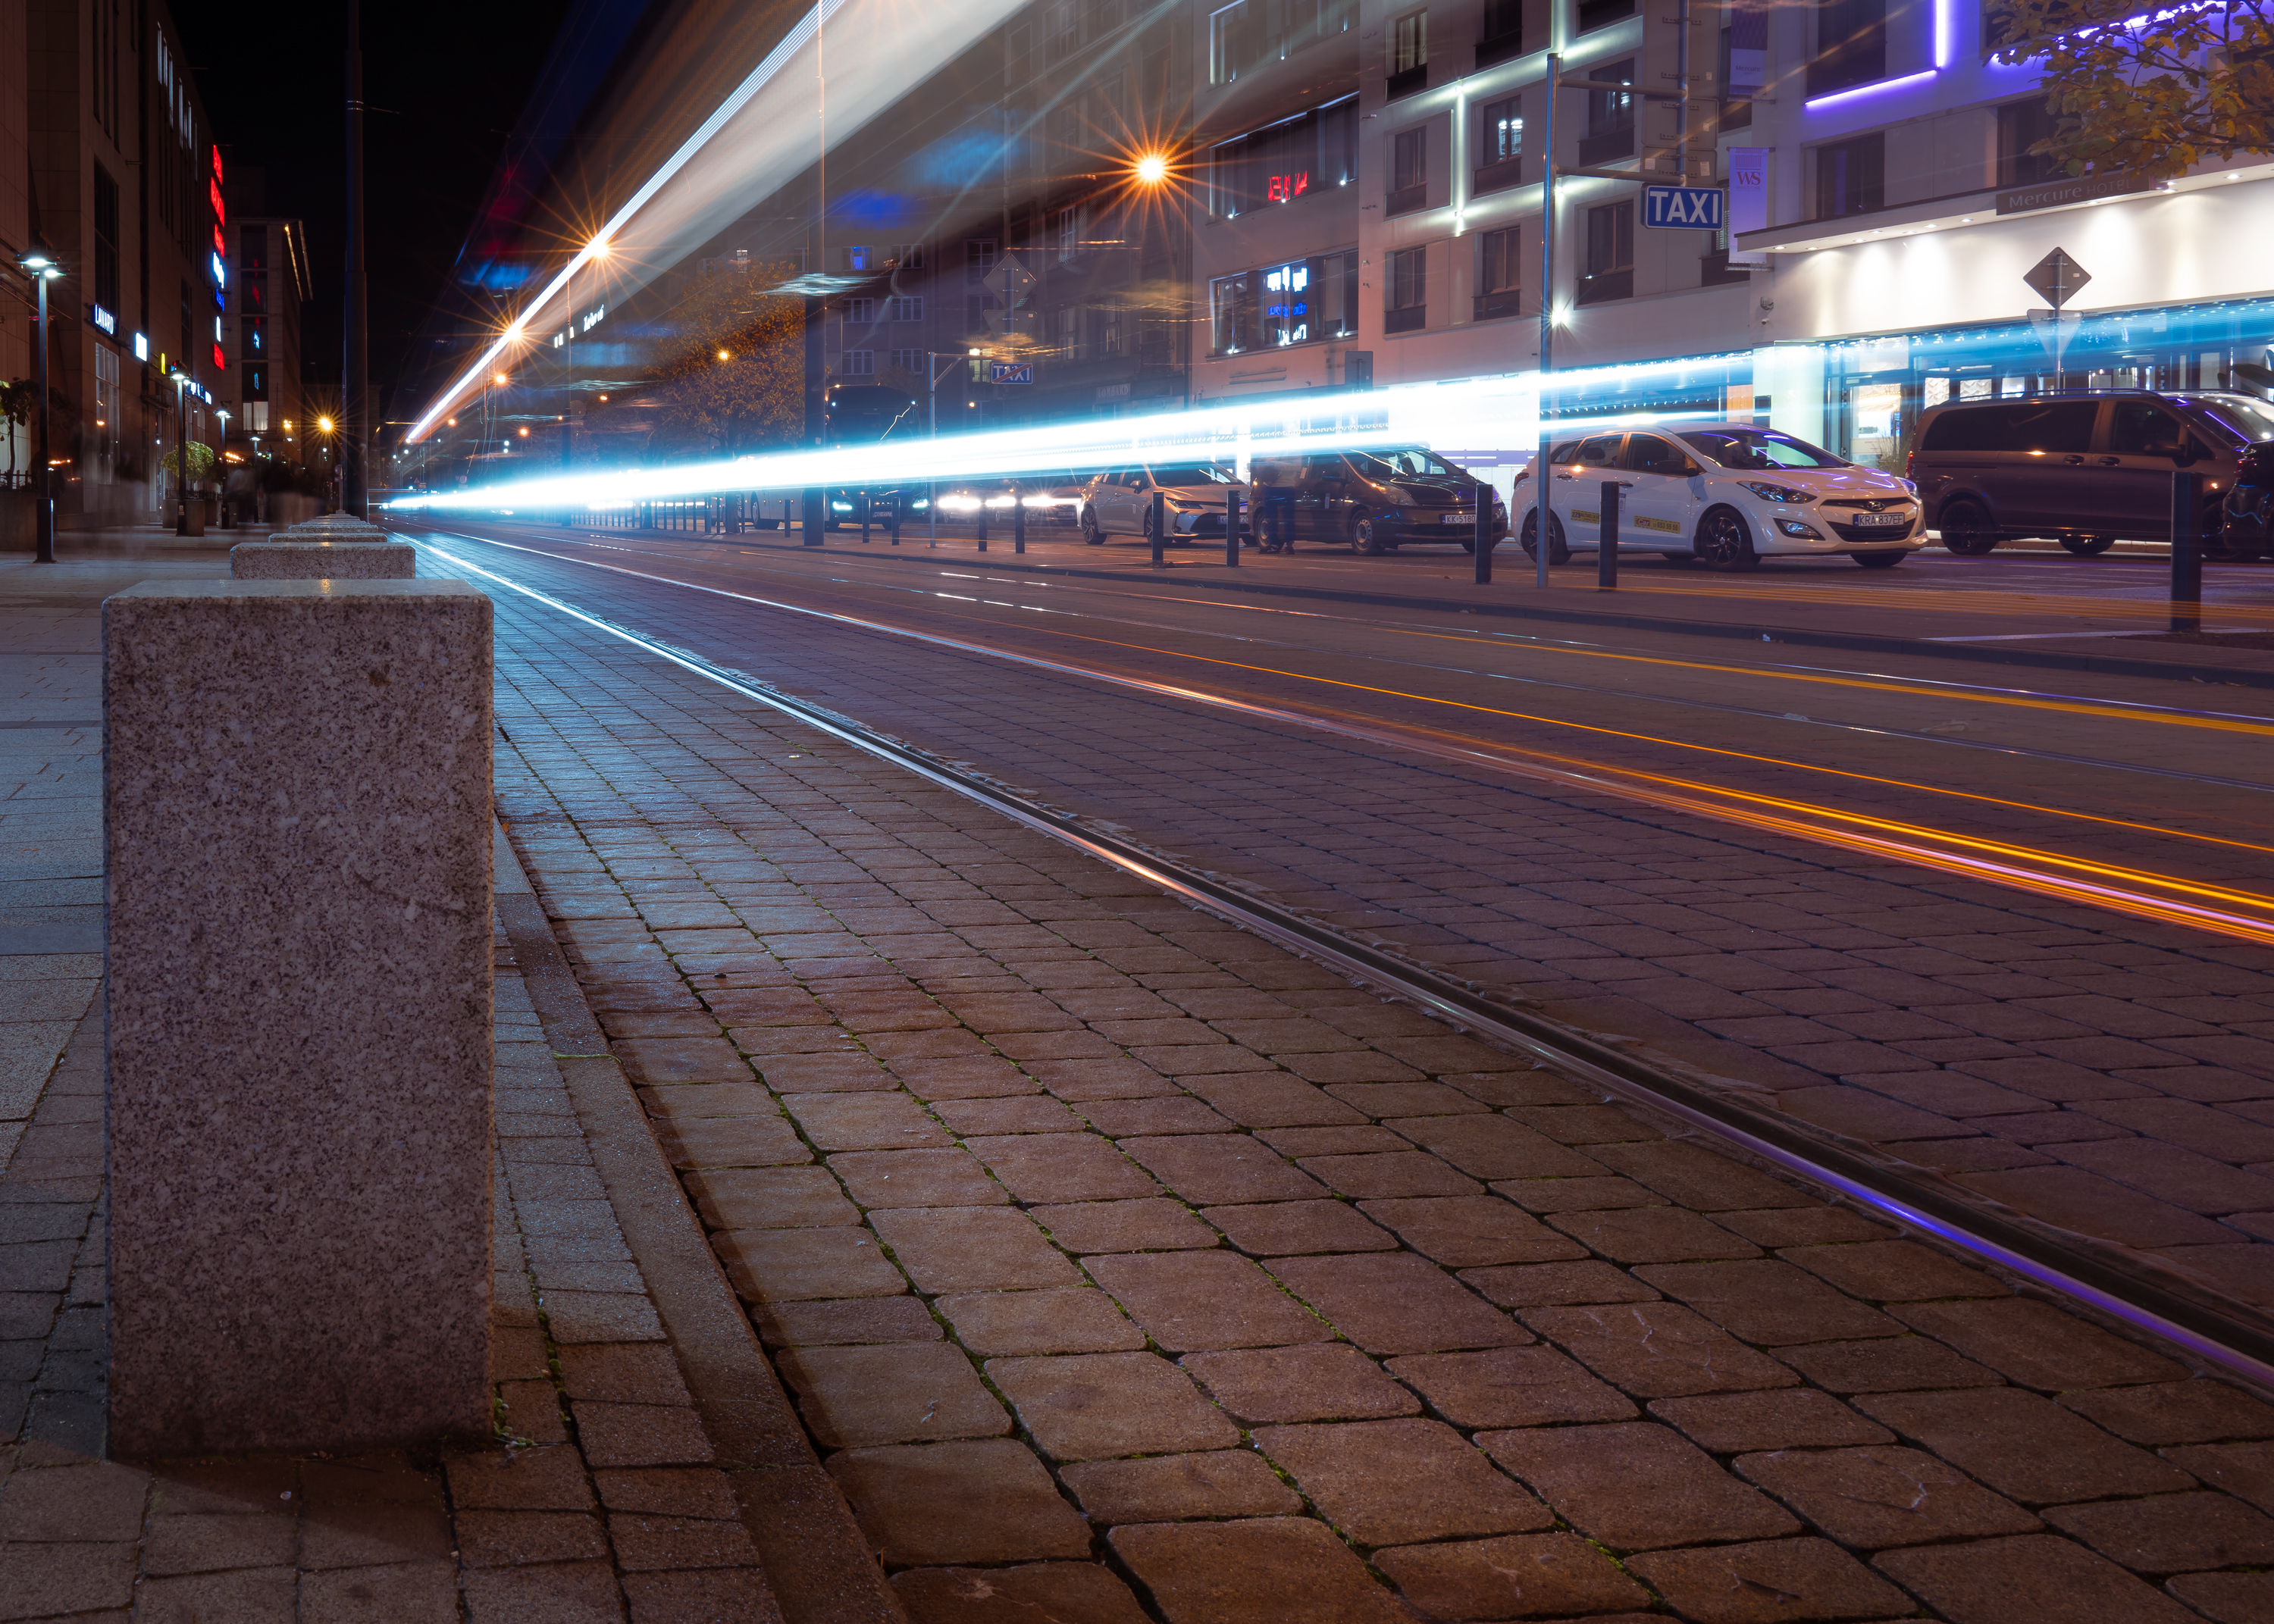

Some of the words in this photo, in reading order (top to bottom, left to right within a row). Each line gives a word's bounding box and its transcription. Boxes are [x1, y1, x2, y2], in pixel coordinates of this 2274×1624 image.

[1736, 171, 1761, 186] WS
[2009, 186, 2082, 208] Mercure
[2087, 179, 2132, 195] HOTEL
[1649, 190, 1719, 224] TAXI
[95, 304, 114, 335] LAVARD
[993, 365, 1030, 381] TAXI
[1098, 386, 1129, 398] LOMBARD
[1859, 515, 1876, 525] KRA
[1878, 515, 1903, 524] 837EF
